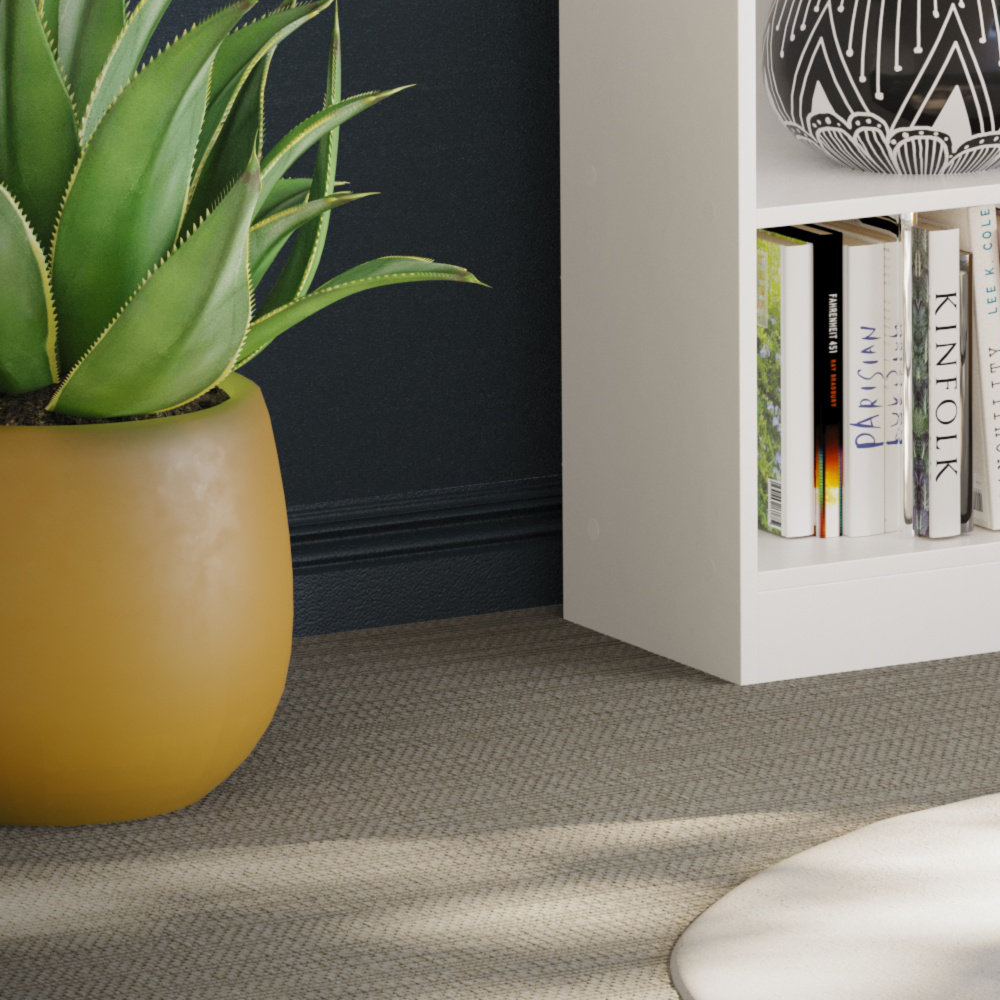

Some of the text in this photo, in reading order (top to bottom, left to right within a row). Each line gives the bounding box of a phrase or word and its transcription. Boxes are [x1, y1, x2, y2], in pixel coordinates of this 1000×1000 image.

[980, 208, 993, 251] COLE
[828, 293, 838, 354] FAHRENHEIT 451
[985, 285, 998, 316] LEE
[850, 326, 884, 449] PARISIAN
[935, 292, 959, 482] KINFOLK
